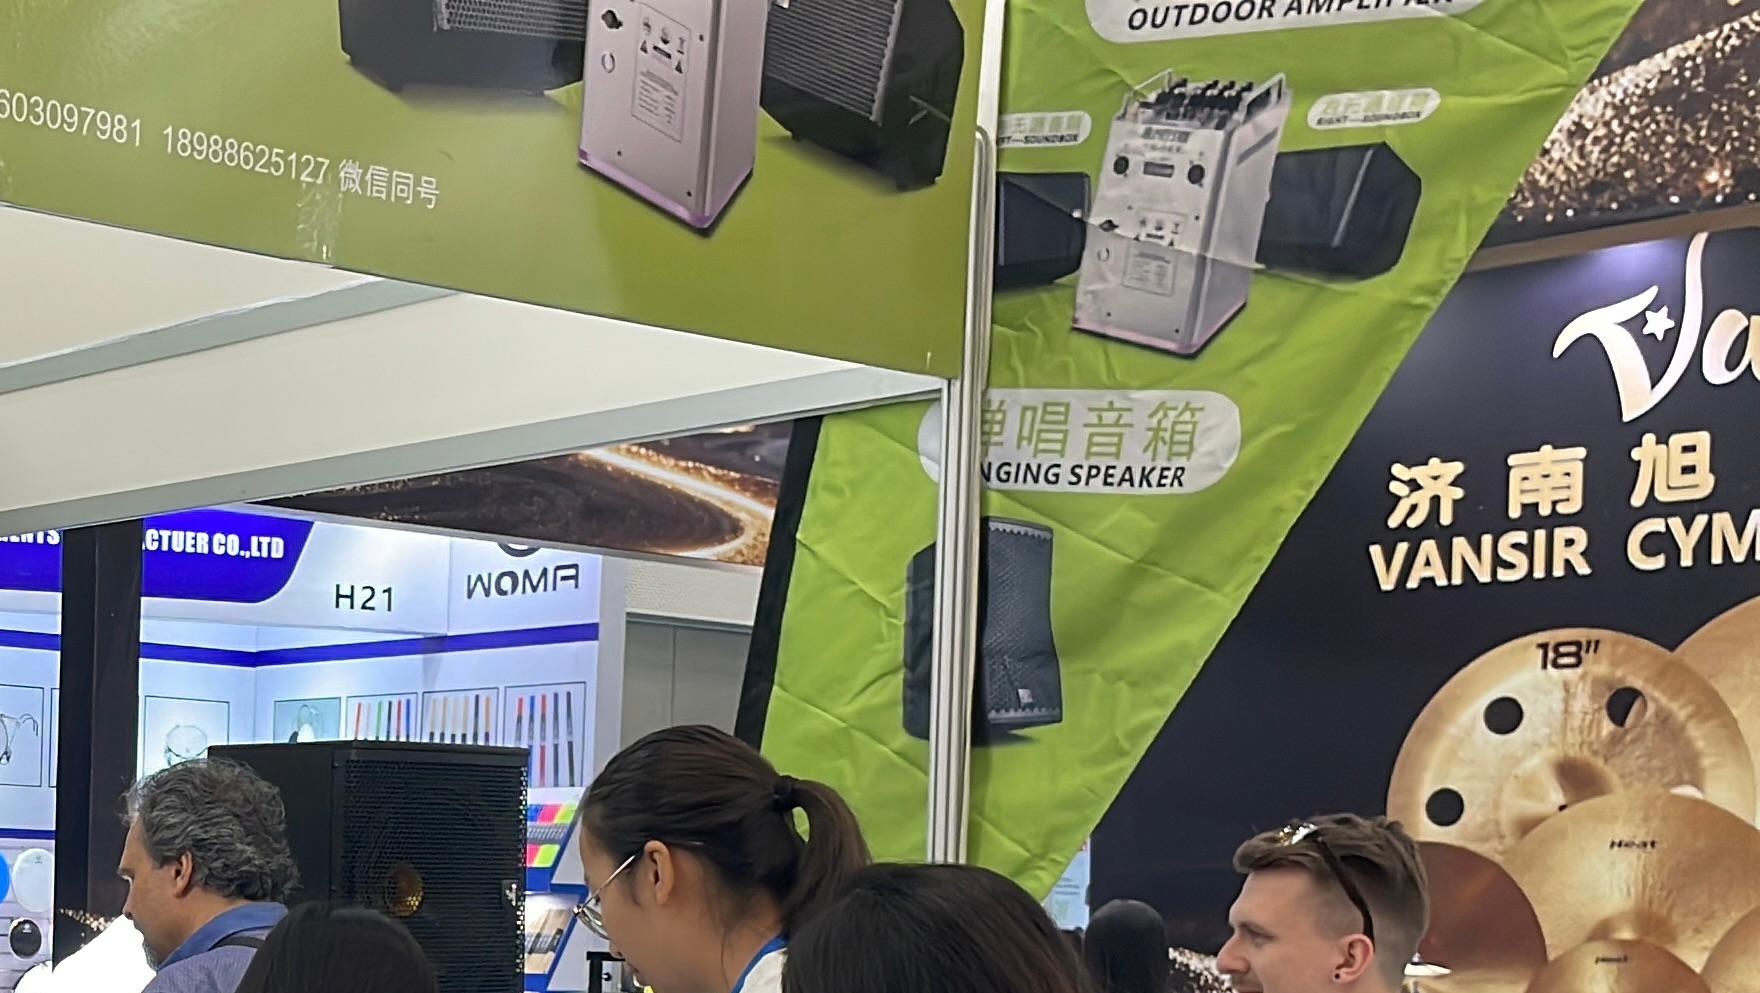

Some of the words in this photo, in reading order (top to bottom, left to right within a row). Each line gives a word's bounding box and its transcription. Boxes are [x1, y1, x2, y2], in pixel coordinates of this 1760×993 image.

[1127, 0, 1275, 32] OUTDOOR
[162, 124, 330, 185] 18988625127
[338, 158, 440, 210] 微信同号
[981, 462, 1061, 485] NGING
[1069, 464, 1186, 488] SPEAKER
[1387, 431, 1715, 529] 济南旭
[142, 528, 209, 555] CTUER
[213, 531, 285, 559] CO.,LTD
[1369, 526, 1592, 592] VANSIR
[334, 583, 393, 612] H21
